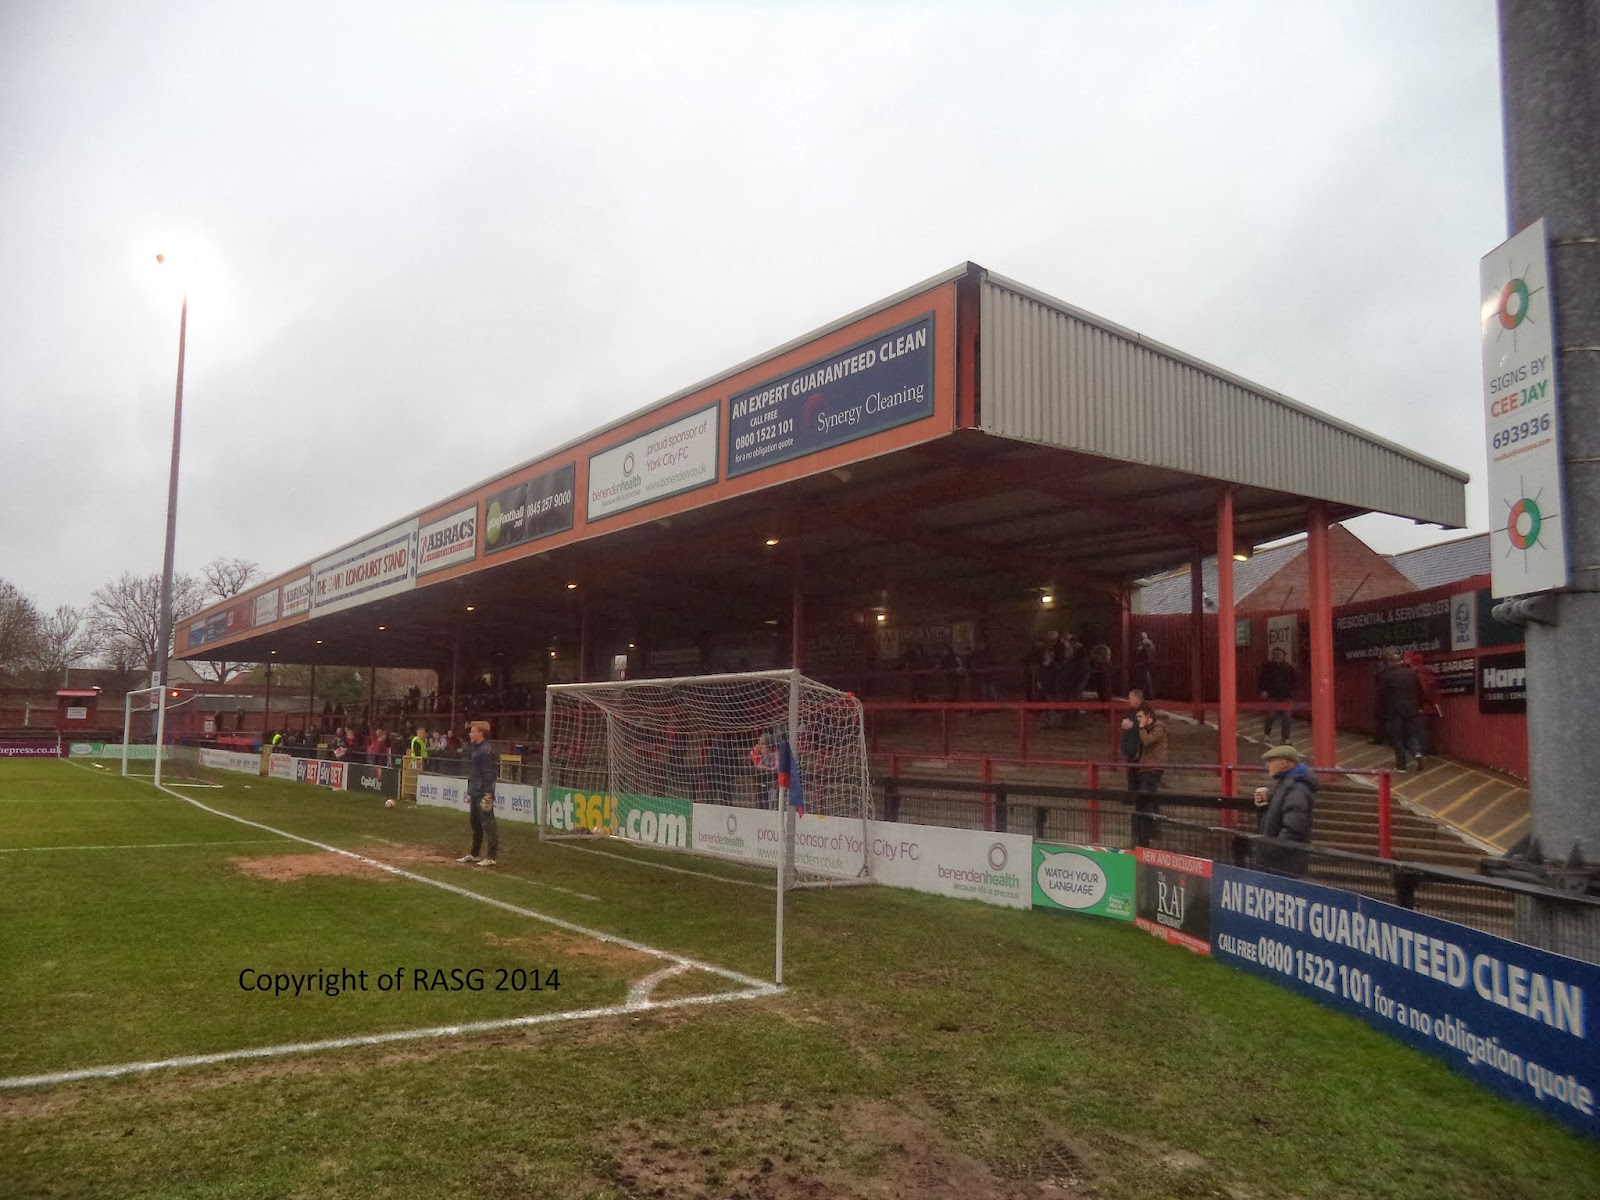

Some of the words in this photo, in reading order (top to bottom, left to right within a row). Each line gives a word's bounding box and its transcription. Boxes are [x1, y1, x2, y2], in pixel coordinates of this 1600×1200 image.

[732, 400, 747, 420] AN
[749, 380, 789, 413] EXPERT
[791, 350, 876, 396] GUARANTEED
[880, 328, 926, 363] CLEAN
[1490, 365, 1526, 394] SIGNS
[1530, 355, 1546, 376] BY
[750, 415, 763, 427] CALL
[764, 410, 778, 422] FREE
[817, 405, 862, 433] Synergy
[865, 384, 924, 414] Cleaning
[647, 437, 668, 457] proud
[668, 428, 698, 448] sponsor
[698, 422, 708, 435] of
[735, 432, 755, 450] 0800
[756, 425, 776, 442] 1522
[778, 418, 793, 435] 101
[1493, 413, 1549, 450] 693936
[646, 456, 662, 472] York
[662, 451, 678, 467] City
[678, 446, 689, 461] FC
[753, 443, 778, 456] obligation
[778, 438, 794, 450] quote
[527, 500, 541, 517] 0845
[541, 496, 553, 512] 257
[553, 490, 571, 507] 9000
[427, 518, 474, 551] ABRACS
[345, 558, 382, 586] LONGHURST
[383, 549, 406, 573] STAND
[1268, 627, 1290, 644] EXIT
[306, 763, 318, 780] BET
[320, 765, 330, 784] sky
[331, 766, 342, 784] BET
[757, 828, 784, 842] prou
[792, 832, 828, 848] ponsor
[831, 834, 843, 850] of
[873, 839, 897, 861] City
[900, 842, 919, 861] FC
[938, 864, 1019, 888] benendenhealth
[1045, 867, 1073, 880] WATCH
[1075, 871, 1099, 884] YOUR
[1143, 850, 1156, 863] NEW
[1157, 853, 1171, 866] AND
[1172, 855, 1202, 873] EXCLUSIVE
[1049, 880, 1094, 896] LANGUAGE
[1220, 880, 1242, 914] AN
[1245, 885, 1306, 932] EXPERT
[1309, 903, 1469, 989] GUARANTEED
[1473, 953, 1585, 1039] CLEAN
[1218, 932, 1236, 955] CALL
[1237, 939, 1257, 963] FREE
[1258, 936, 1293, 976] 0800
[1295, 950, 1336, 994] 1522
[1339, 965, 1373, 1009] 101
[1374, 985, 1396, 1019] for
[1398, 1002, 1408, 1026] a
[1410, 1007, 1432, 1036] no
[1434, 1015, 1524, 1082] obligation
[1526, 1061, 1594, 1116] quote
